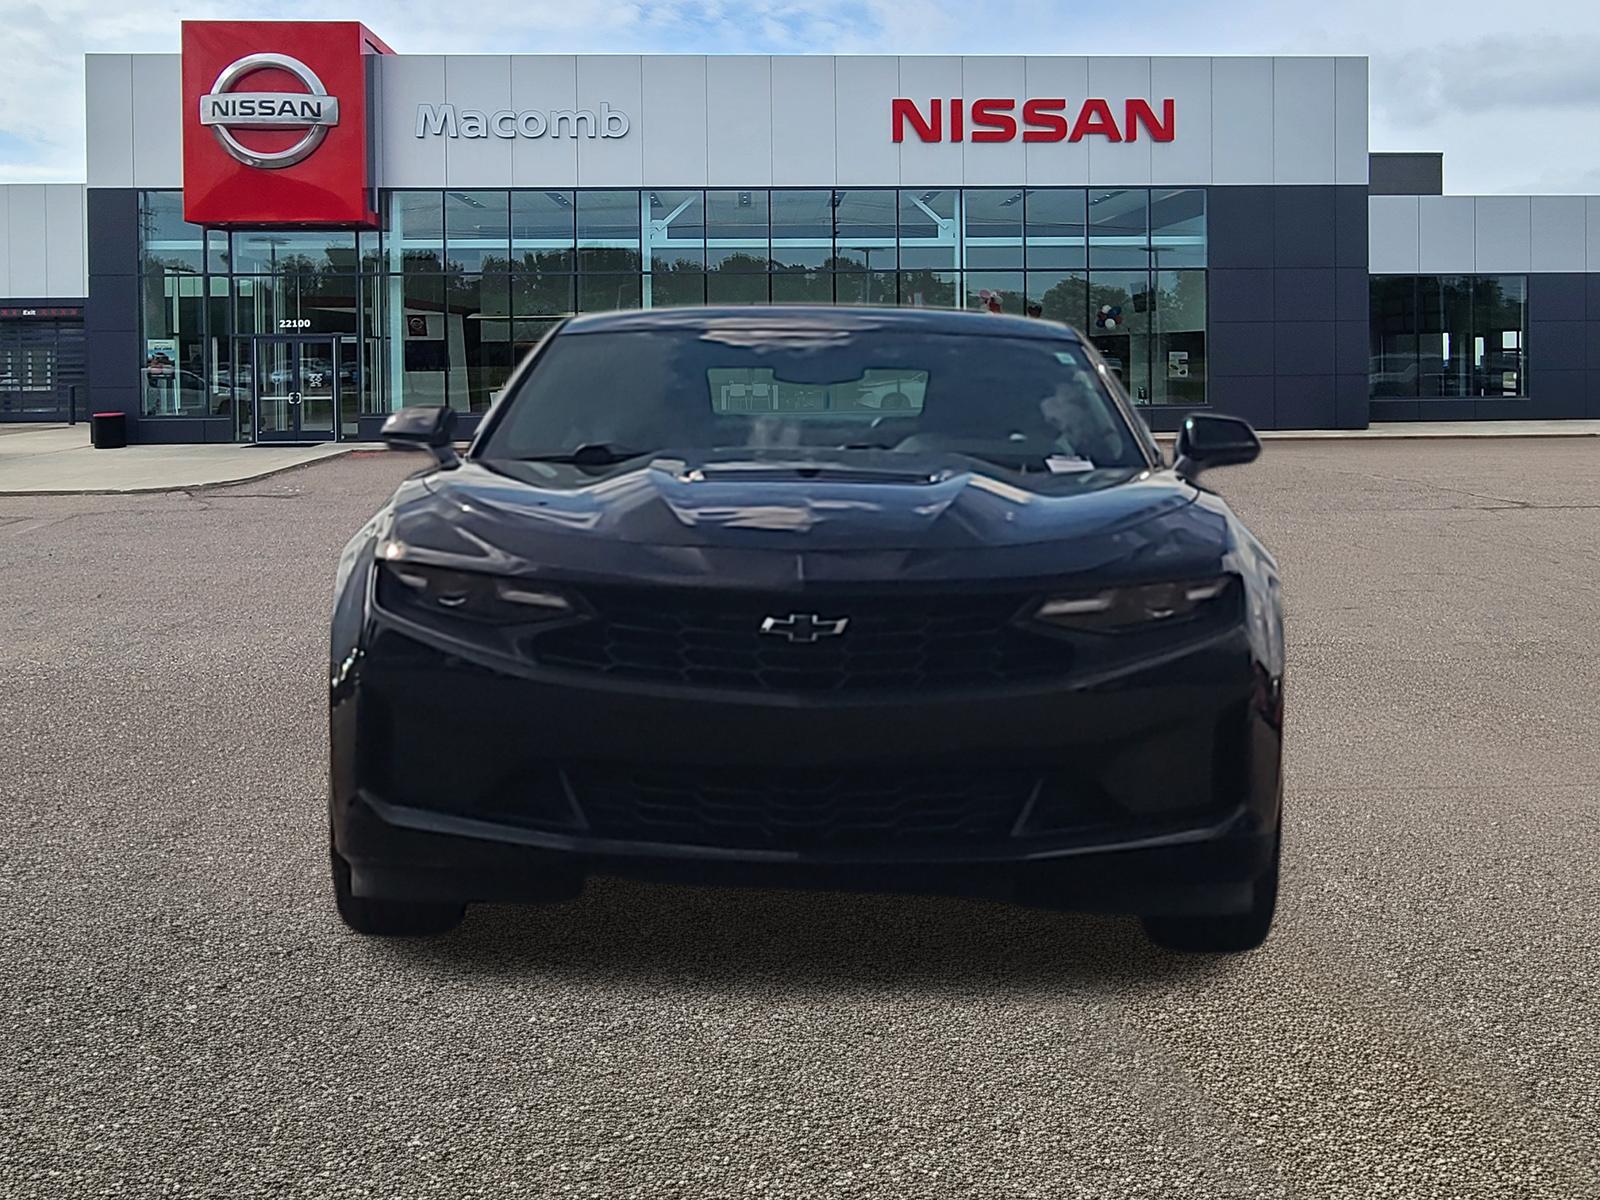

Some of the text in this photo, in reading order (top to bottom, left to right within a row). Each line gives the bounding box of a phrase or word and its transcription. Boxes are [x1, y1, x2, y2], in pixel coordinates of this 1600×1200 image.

[212, 100, 322, 117] NISSAN
[415, 101, 630, 139] Macomb
[892, 98, 1175, 143] NISSAN
[279, 319, 311, 328] 22100
